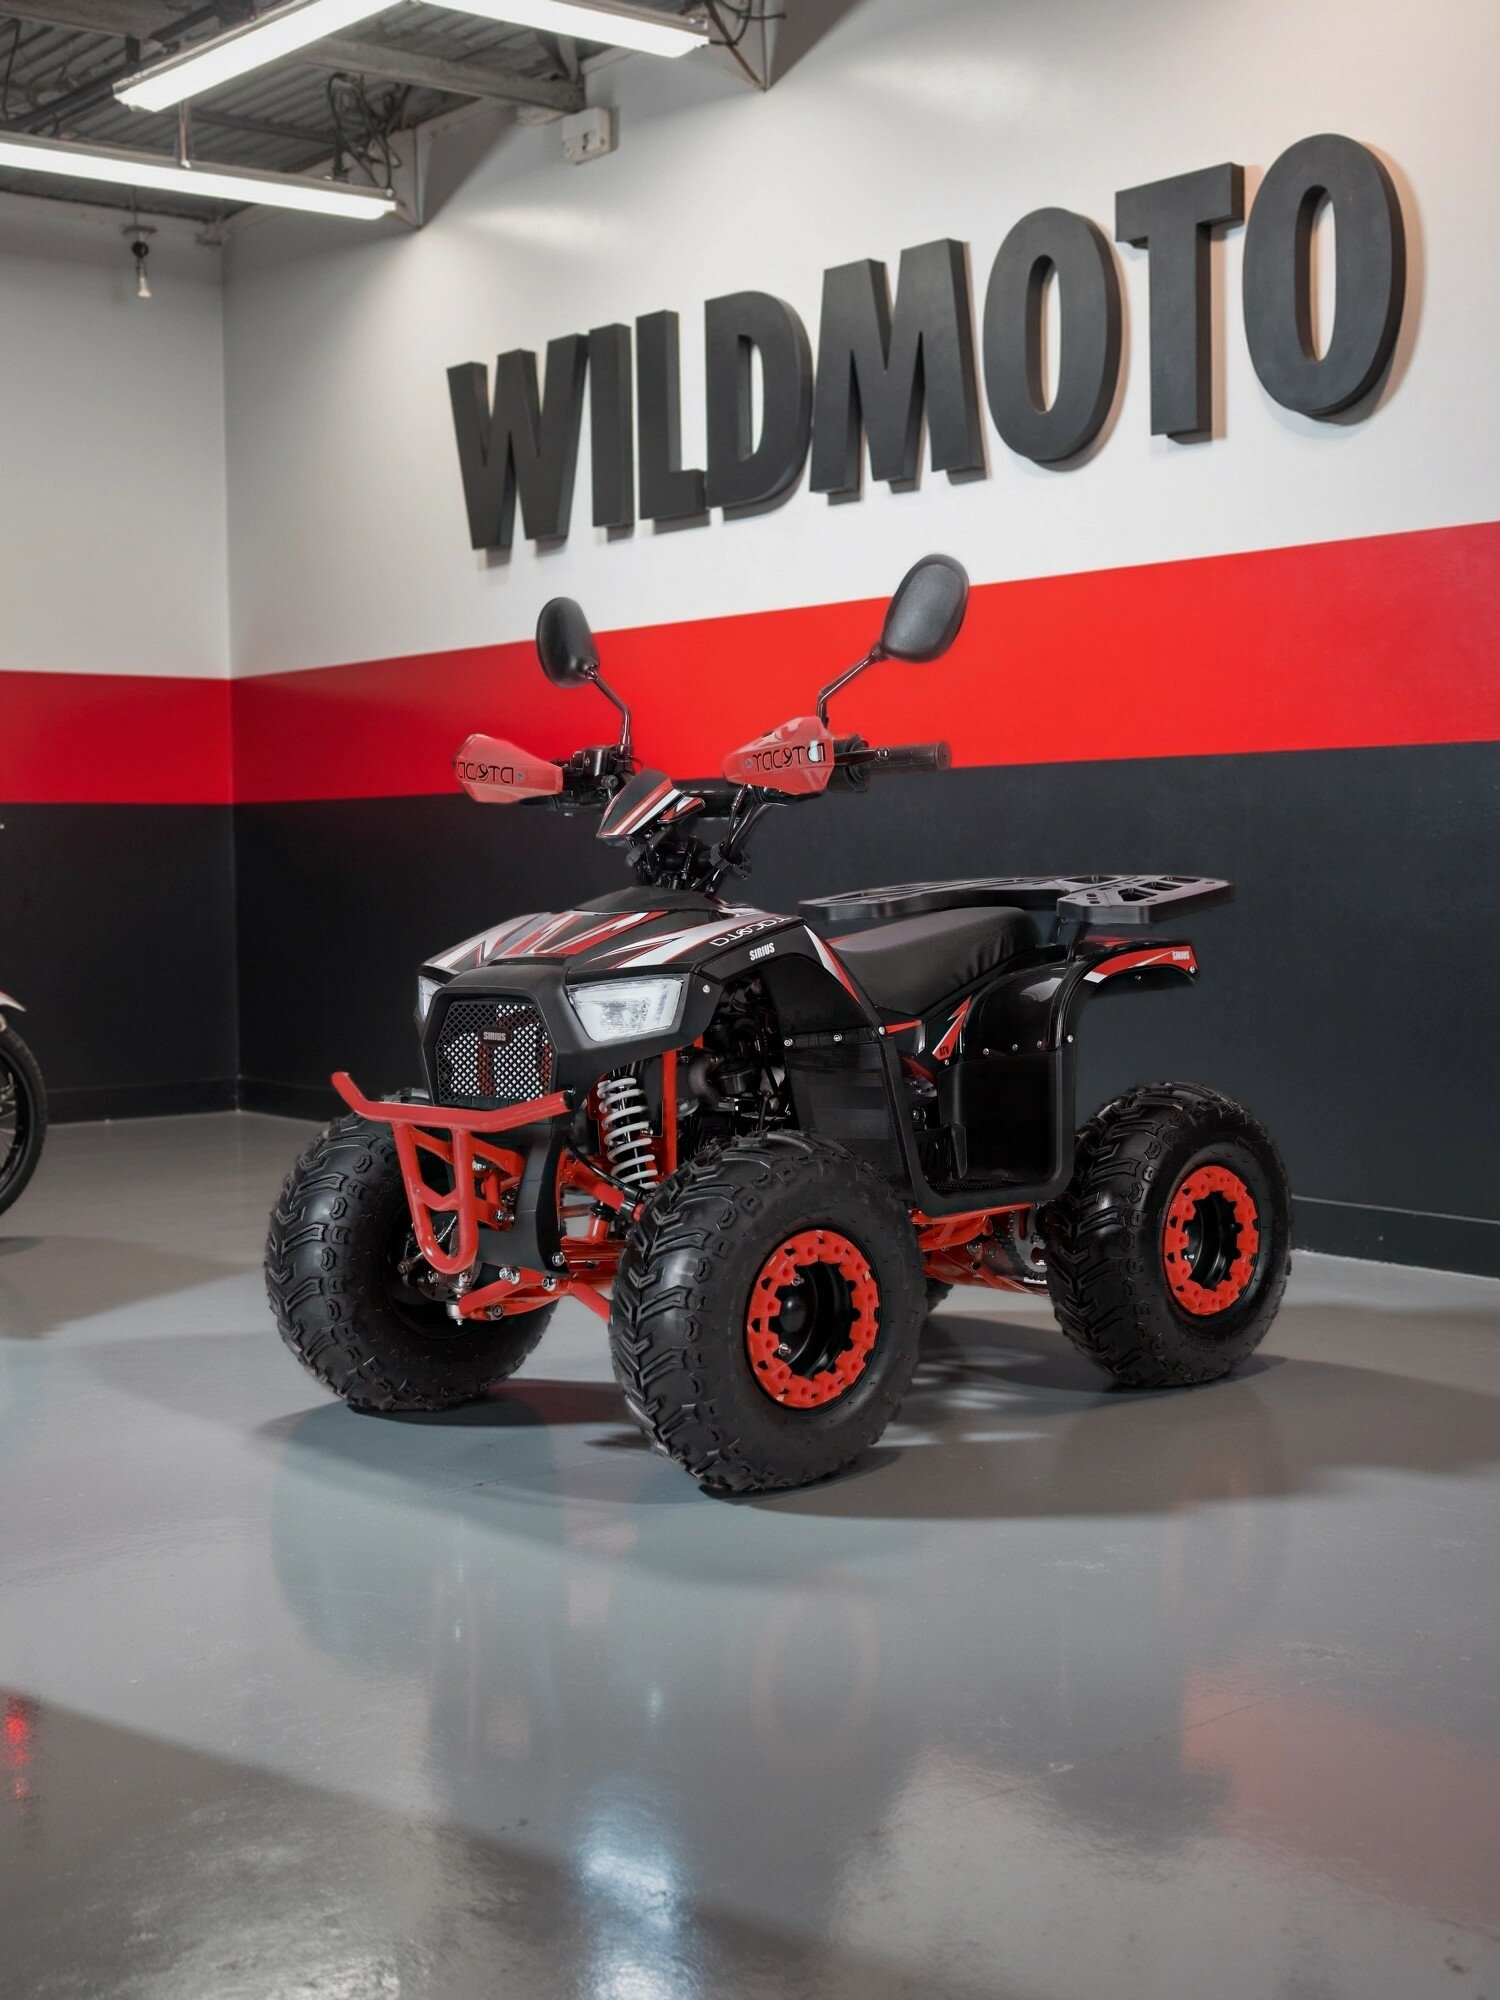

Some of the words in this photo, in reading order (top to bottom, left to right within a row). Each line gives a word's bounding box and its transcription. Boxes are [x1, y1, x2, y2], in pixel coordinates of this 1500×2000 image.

[447, 133, 1406, 552] WILDMOTO
[749, 942, 775, 961] SIRIUS
[483, 1031, 506, 1042] SIRIUS
